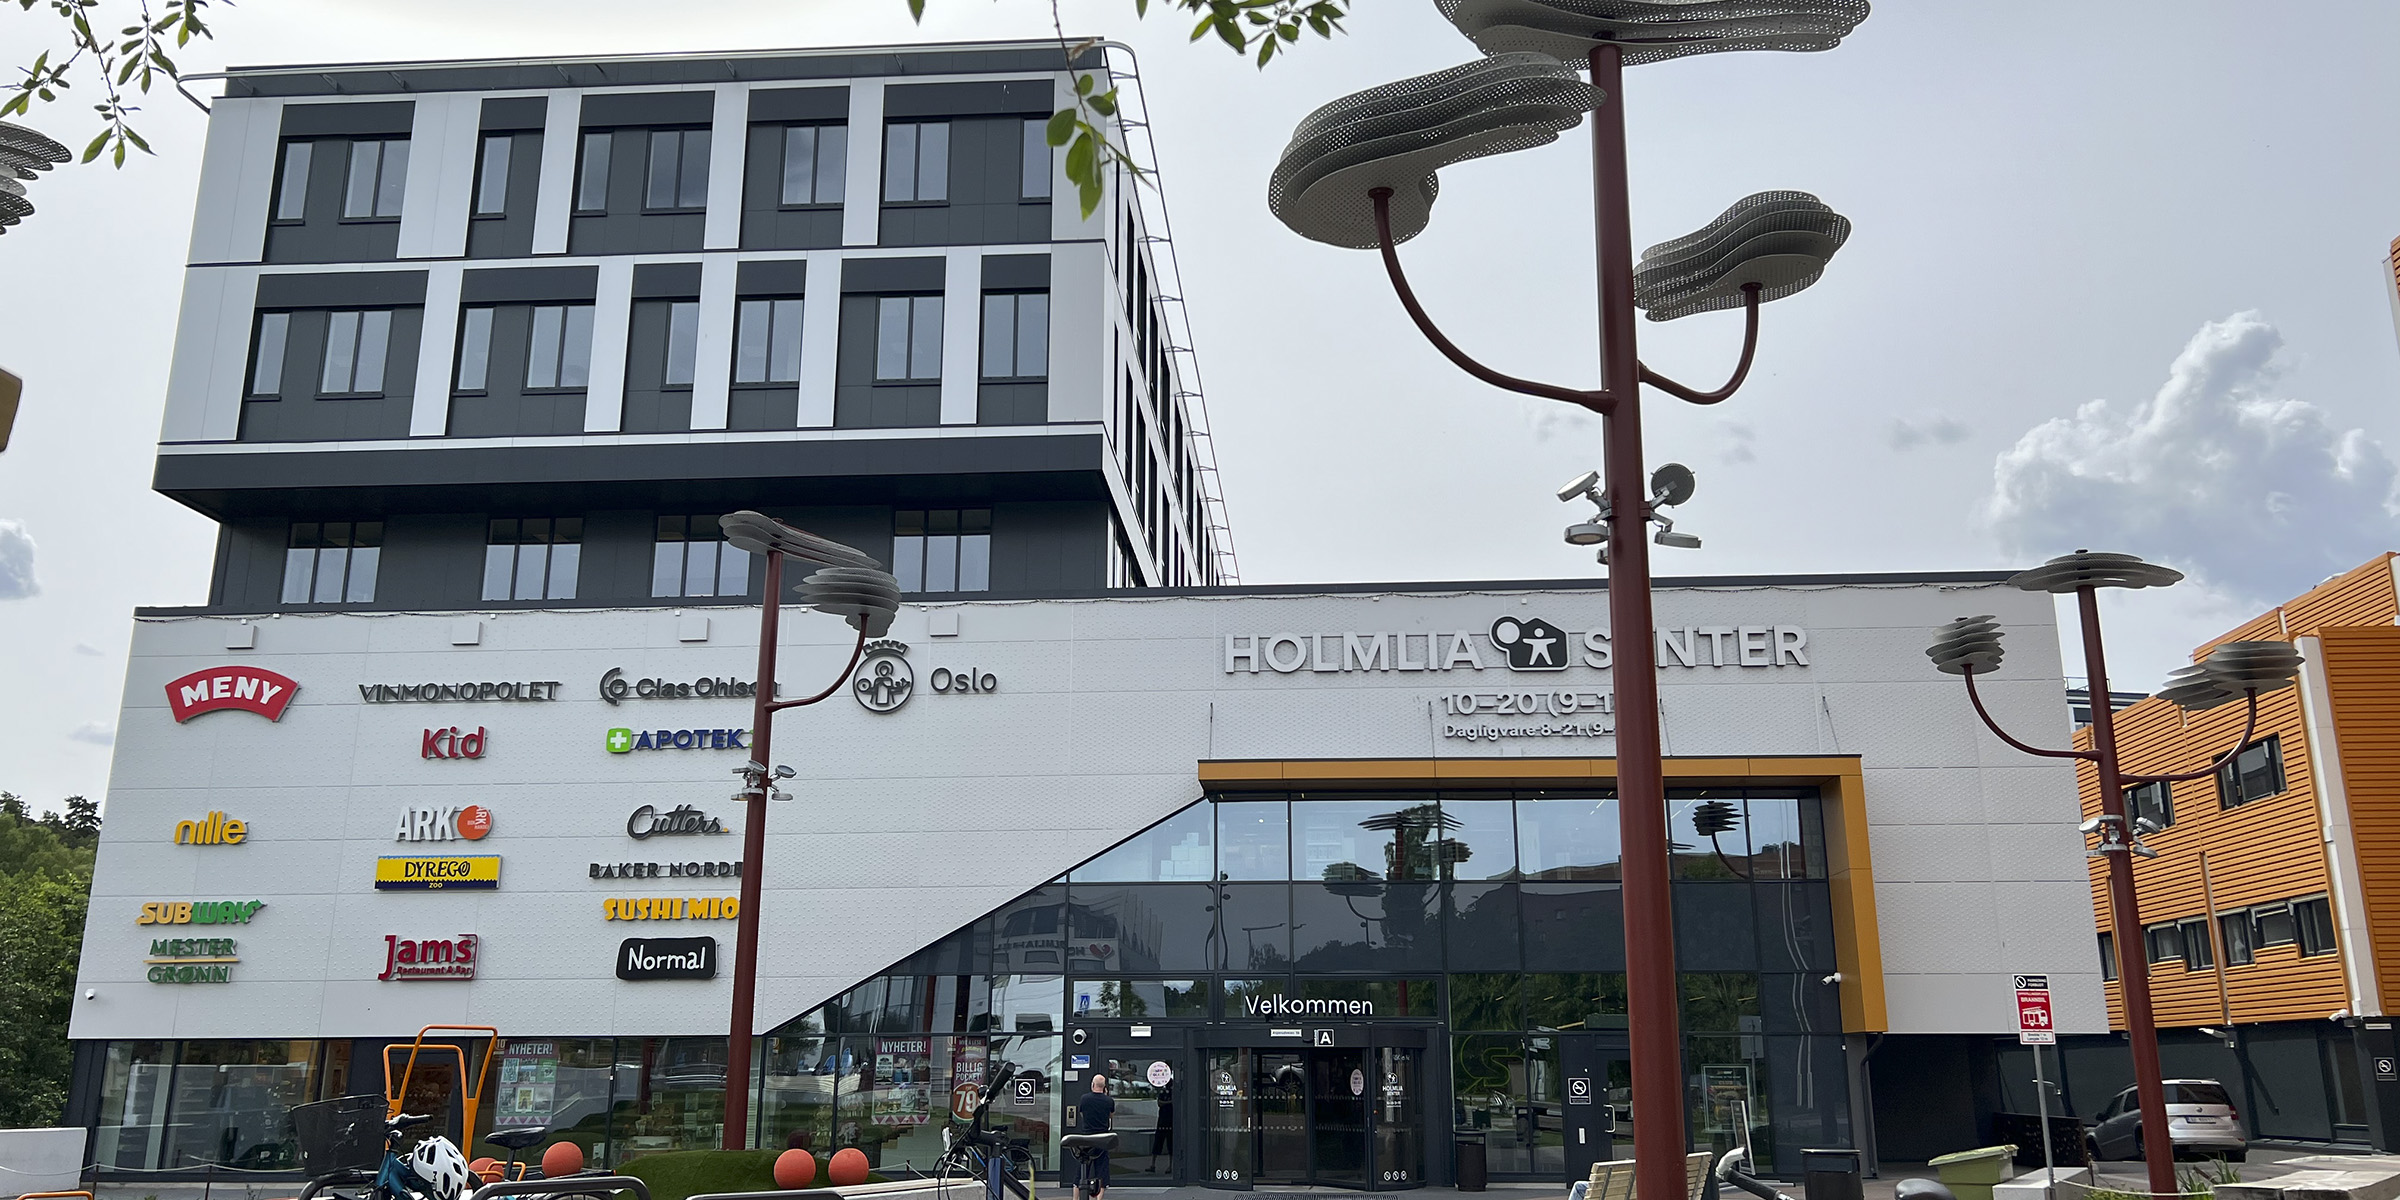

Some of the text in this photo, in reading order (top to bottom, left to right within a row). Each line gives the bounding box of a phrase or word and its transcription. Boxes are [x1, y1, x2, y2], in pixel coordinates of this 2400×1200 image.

[1225, 625, 1810, 673] HOLMLIA SNTER
[180, 675, 283, 707] MENY
[358, 681, 561, 701] VINMONOPOLET
[635, 678, 691, 698] Clas
[930, 667, 998, 693] Oslo
[421, 726, 487, 759] Kid
[635, 729, 745, 750] APOTEK
[1444, 724, 1536, 741] Dagligvare
[174, 811, 248, 845] nille
[395, 805, 457, 841] ARK
[589, 862, 659, 879] BAKER
[135, 899, 263, 925] SUBWAY
[603, 896, 740, 921] SUSHI MIO
[149, 938, 237, 956] MESTER
[378, 934, 472, 980] Jams
[627, 944, 706, 971] Normal
[455, 965, 472, 975] Bar
[1245, 994, 1374, 1016] Velkommen
[509, 1043, 553, 1055] NYHETER!
[881, 1041, 927, 1053] NYHETER!
[1320, 1031, 1332, 1045] A
[956, 1062, 983, 1073] BILLIG
[956, 1091, 977, 1113] 79
